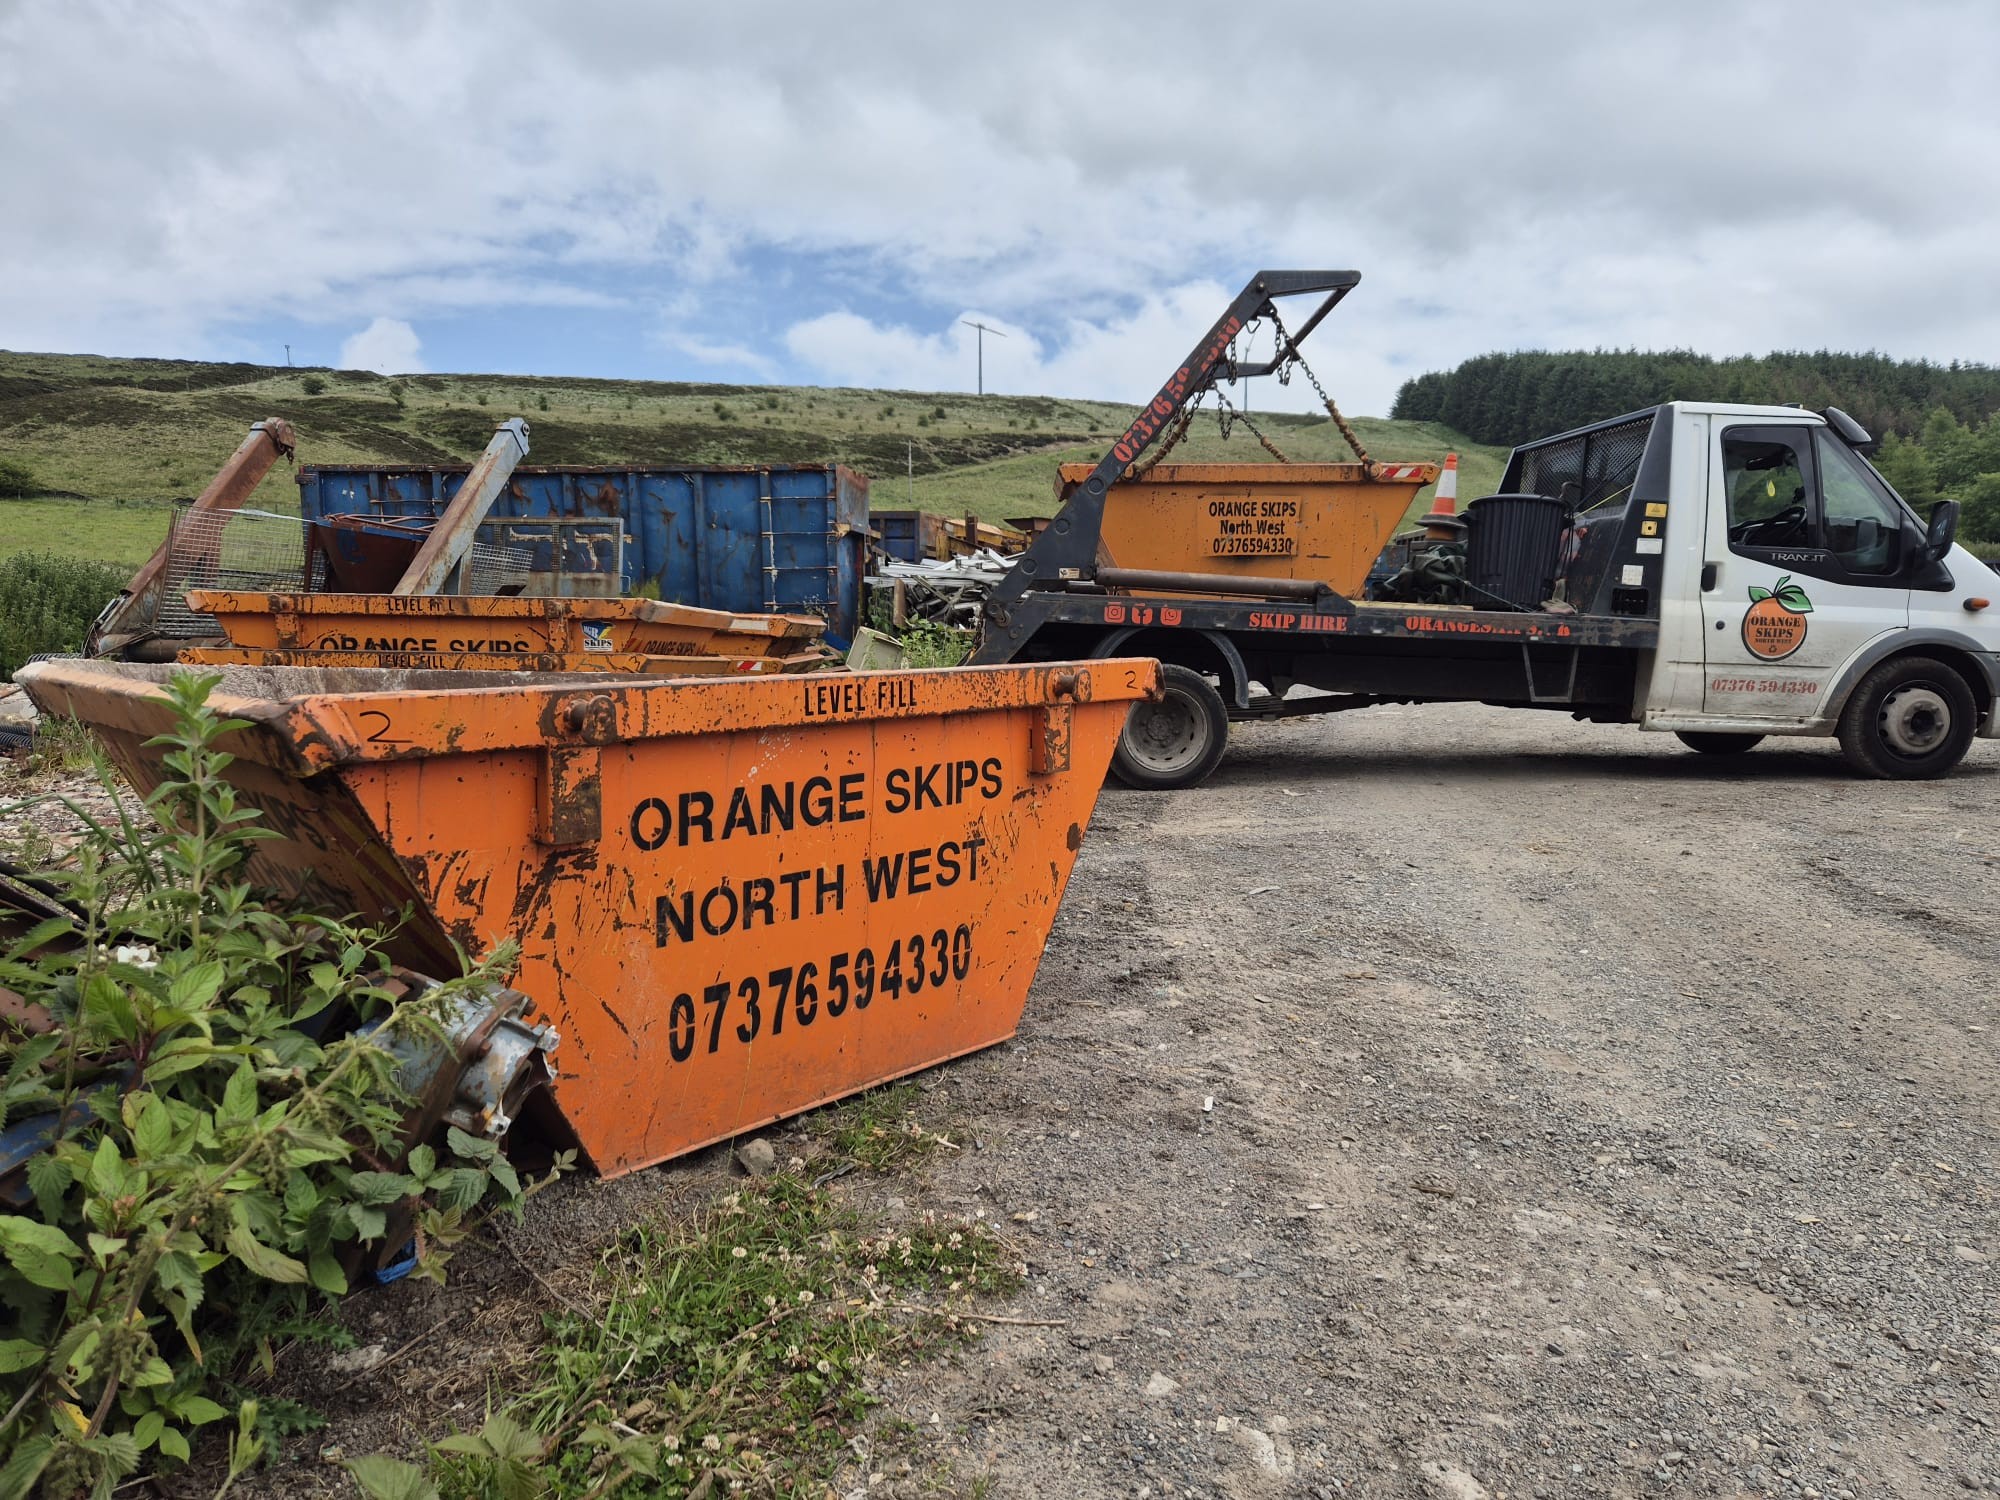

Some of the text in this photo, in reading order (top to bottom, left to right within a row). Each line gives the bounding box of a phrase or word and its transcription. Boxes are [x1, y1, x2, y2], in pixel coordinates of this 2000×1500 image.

[1114, 395, 1173, 462] 07376
[1208, 502, 1297, 517] ORANGE SKIPS
[1220, 520, 1285, 535] North West
[1213, 538, 1292, 553] 07376594330
[1770, 552, 1827, 562] TRANSIT
[388, 598, 423, 612] LEVEL
[1249, 612, 1348, 632] SKIP HIRE
[1751, 616, 1801, 638] ORANGE SKIPS
[584, 639, 612, 647] SKIPS
[378, 655, 414, 669] LEVEL
[1125, 670, 1139, 690] 2
[1712, 679, 1755, 692] 07376
[803, 679, 918, 717] LEVEL FILL
[360, 710, 414, 743] 2
[630, 757, 1003, 852] ORANGE SKIPS
[656, 838, 986, 949] NORTH WEST
[669, 922, 973, 1063] 07376594330
